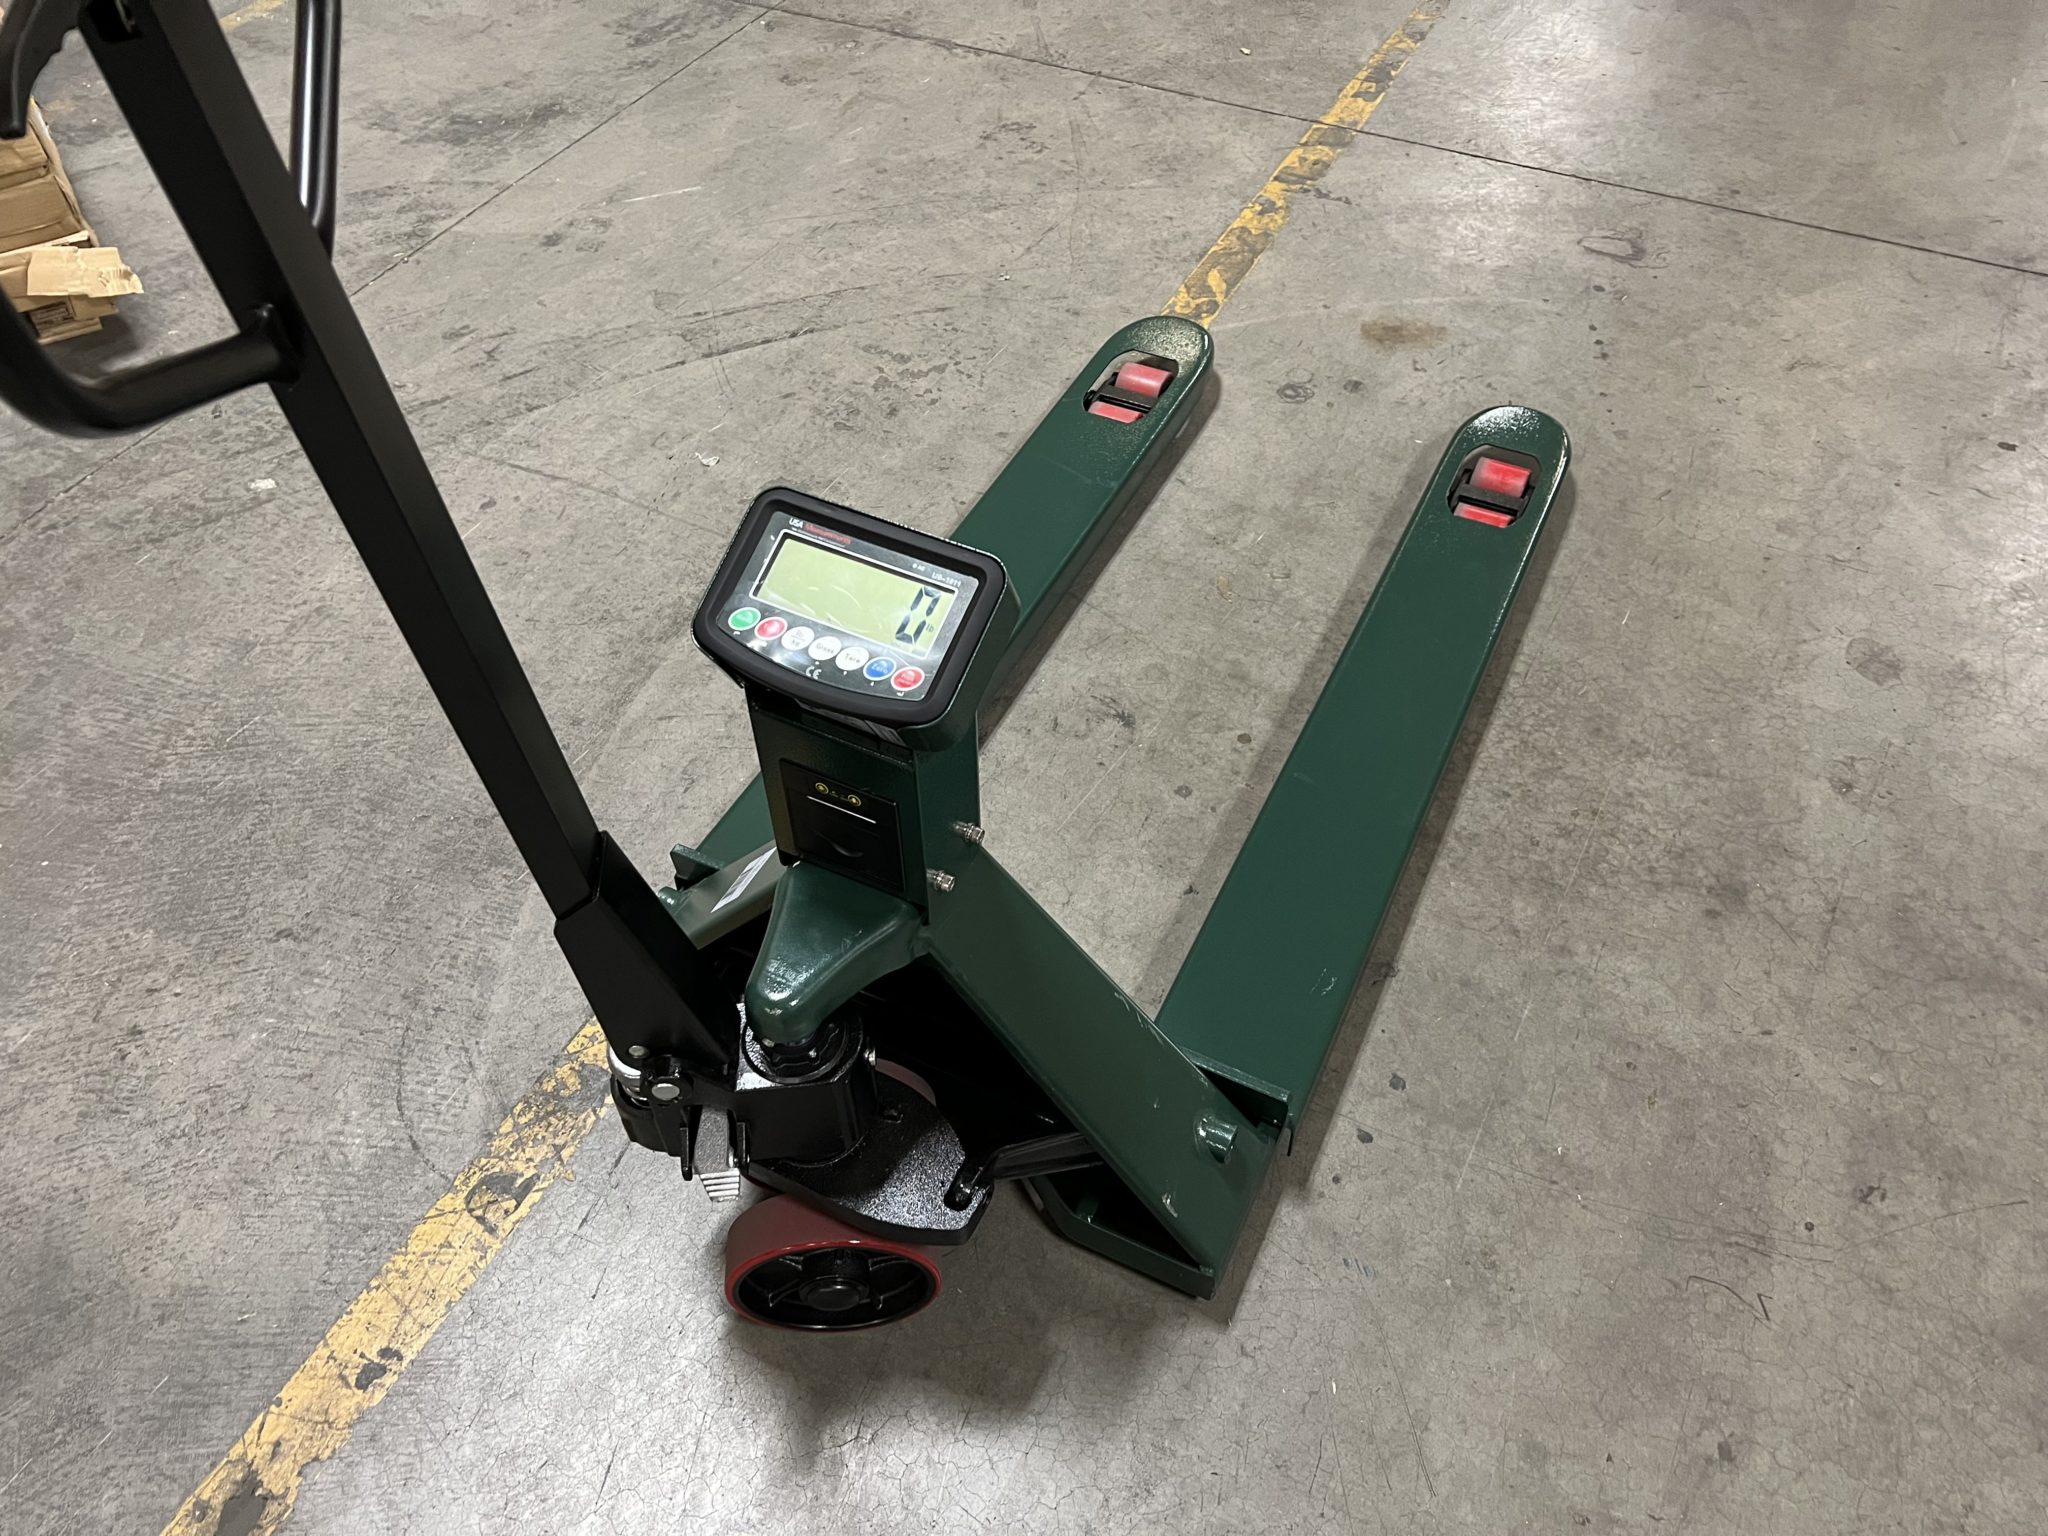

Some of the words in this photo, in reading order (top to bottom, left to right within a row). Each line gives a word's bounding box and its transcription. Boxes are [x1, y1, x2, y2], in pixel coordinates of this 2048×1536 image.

[789, 517, 804, 529] USA
[896, 586, 941, 645] 0
[871, 663, 889, 674] Zero
